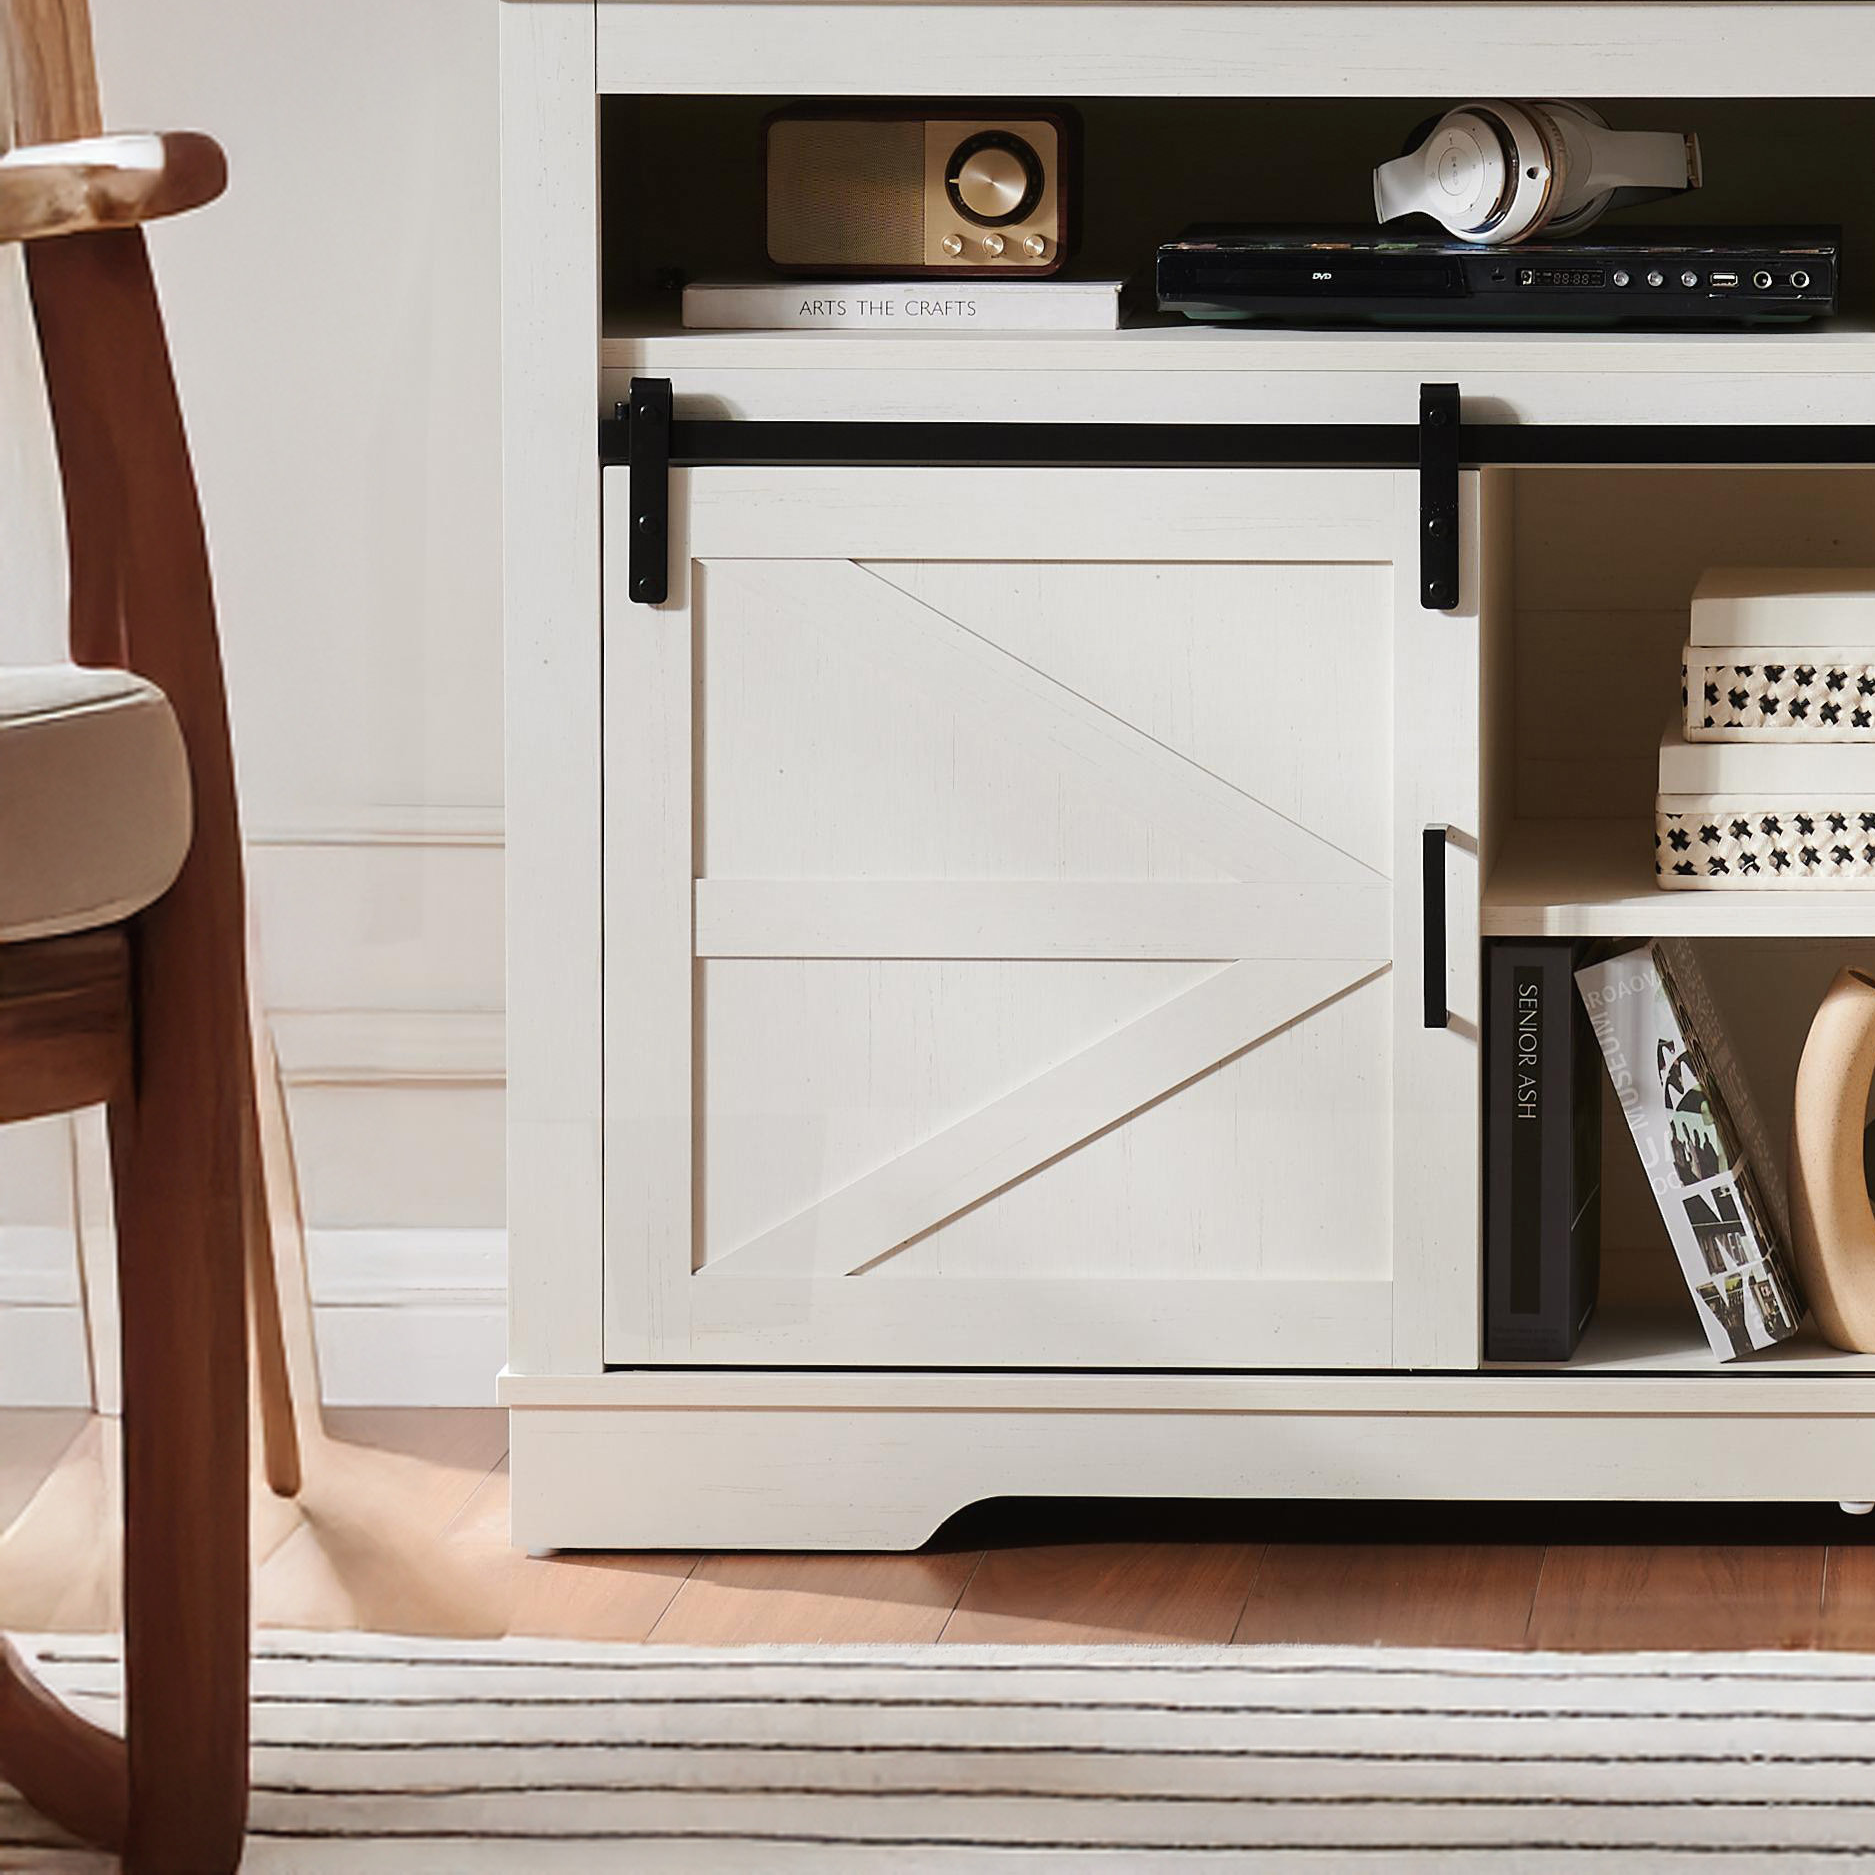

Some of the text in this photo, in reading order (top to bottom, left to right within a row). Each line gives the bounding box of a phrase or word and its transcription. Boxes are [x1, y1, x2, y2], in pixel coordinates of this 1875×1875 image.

[799, 300, 976, 316] ARTS THE CRAFTS
[1312, 272, 1332, 280] DVD
[1517, 984, 1539, 1119] SENIOR ASH
[1590, 1011, 1649, 1131] MUSEUM
